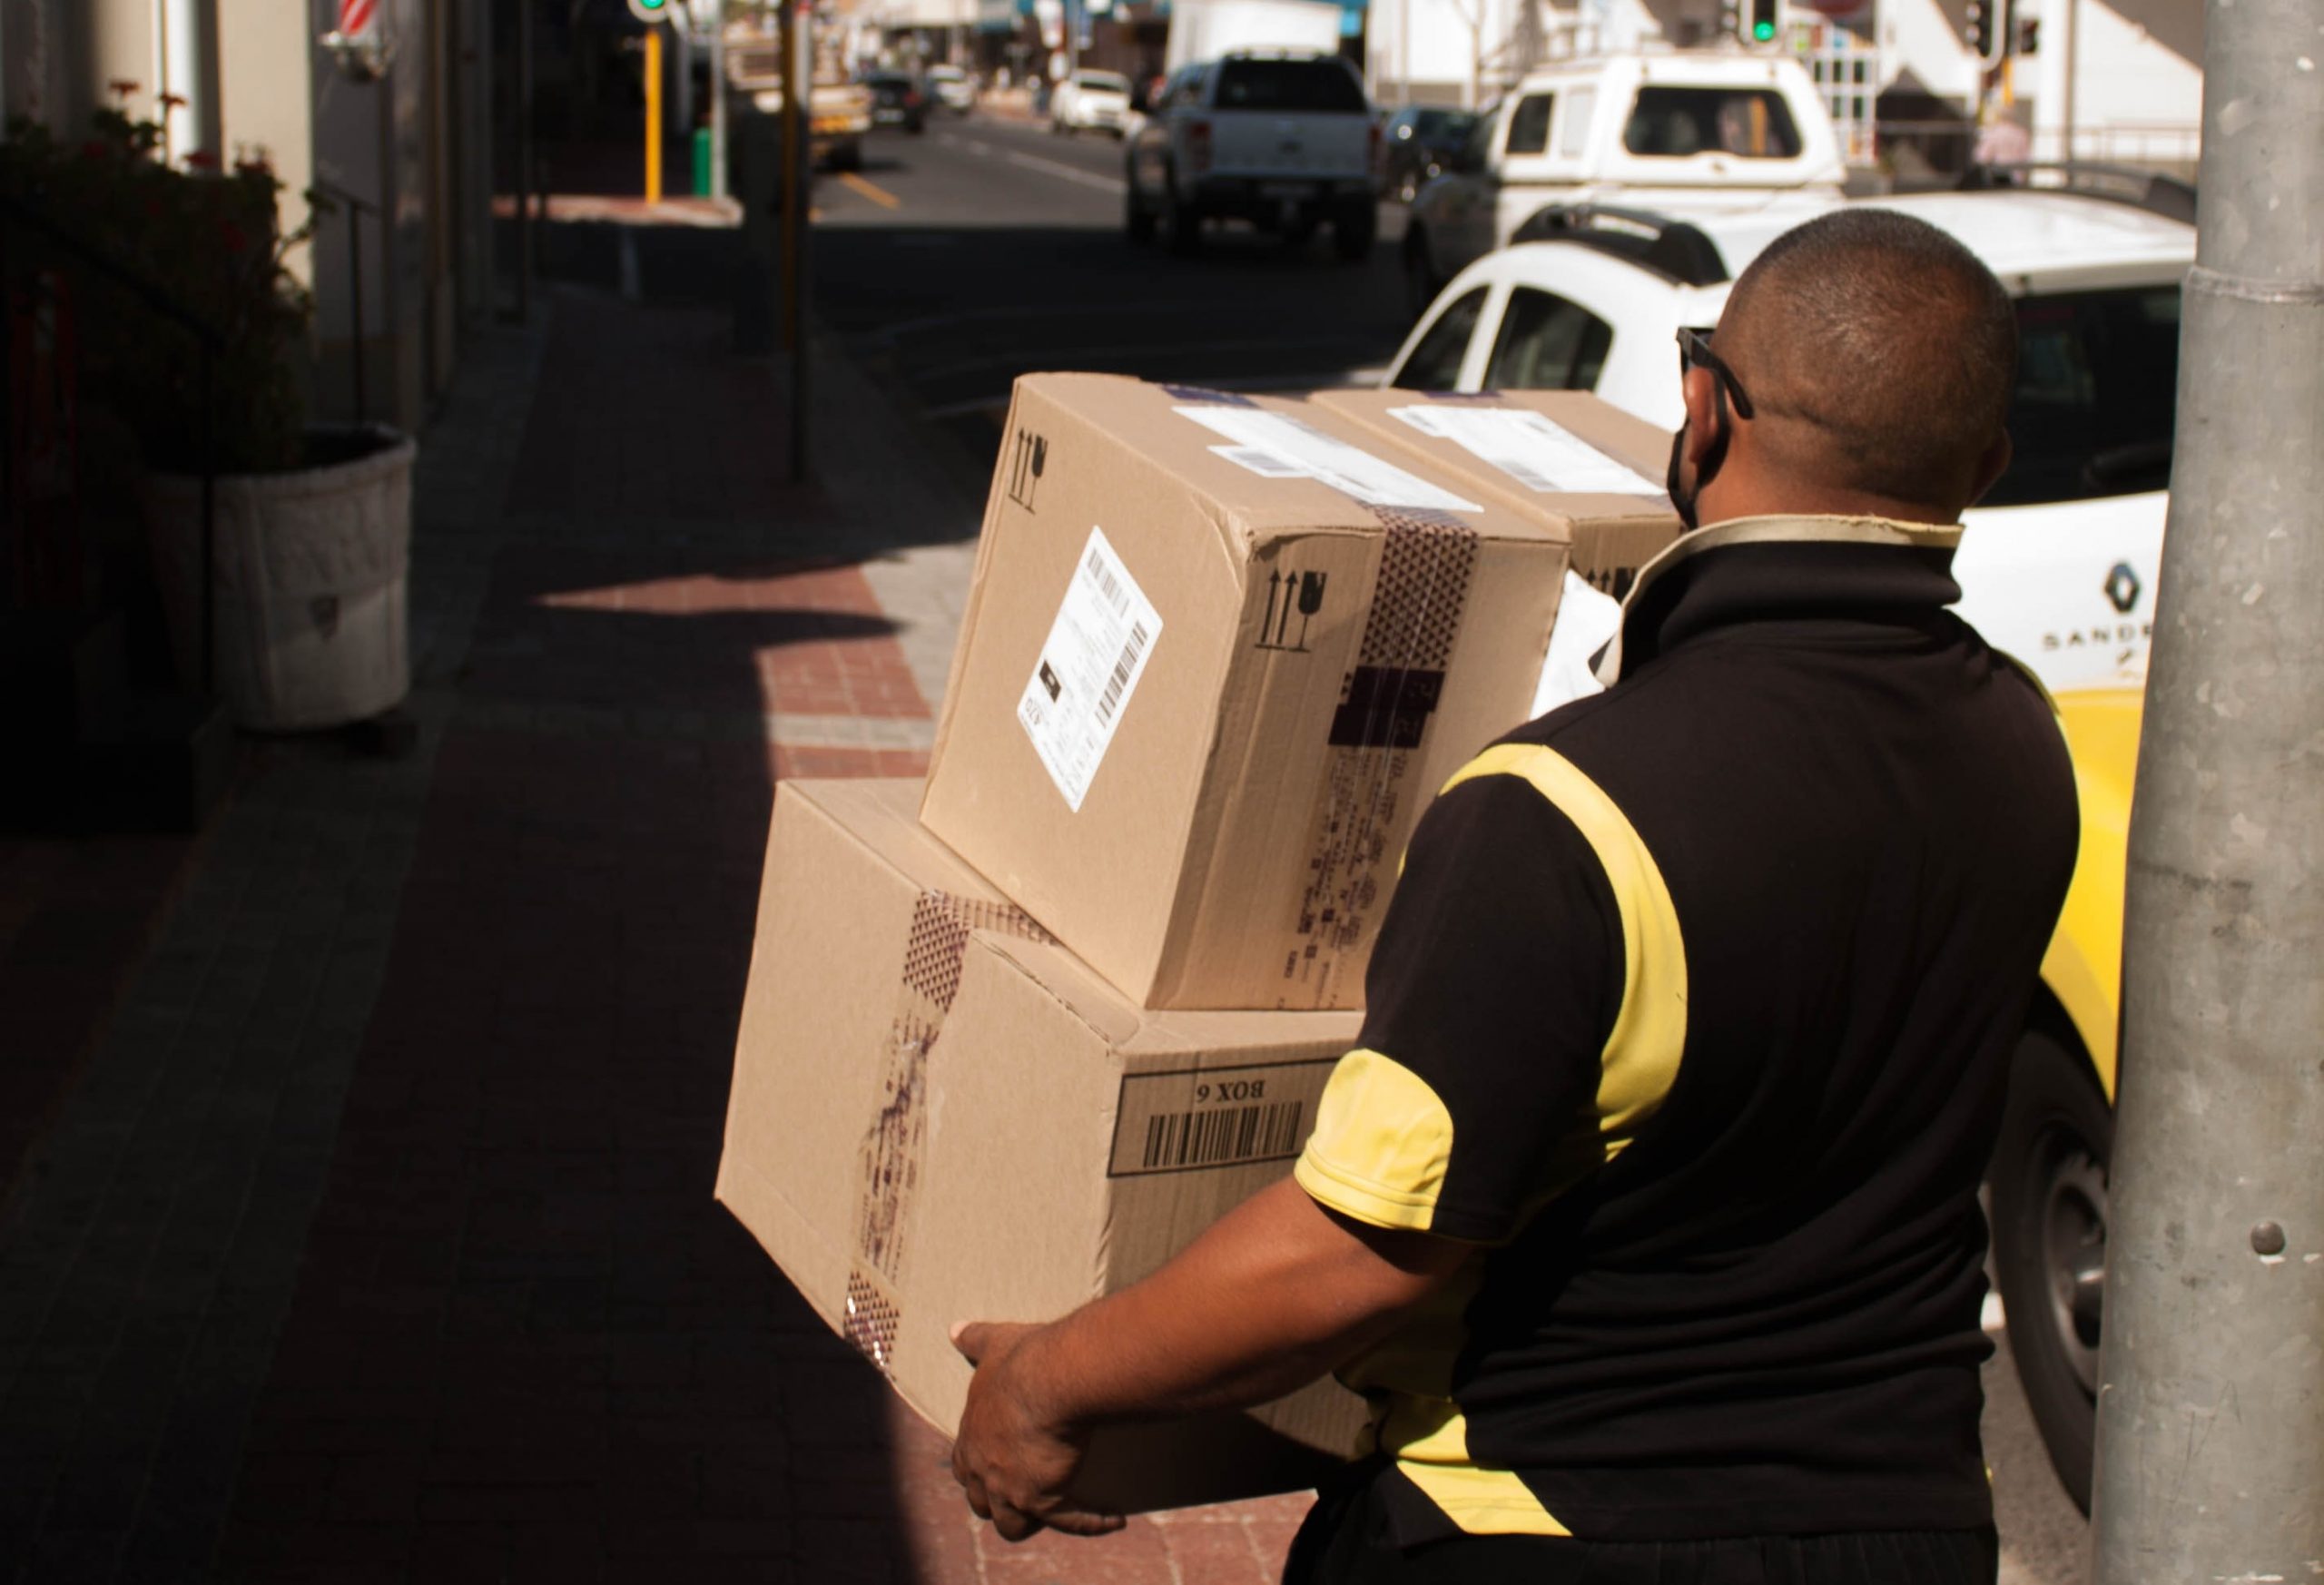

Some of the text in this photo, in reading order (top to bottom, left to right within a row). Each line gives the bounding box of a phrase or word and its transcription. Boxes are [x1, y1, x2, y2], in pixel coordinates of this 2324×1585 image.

[2042, 623, 2152, 651] SANDE
[1197, 1079, 1265, 1103] BOX 6
